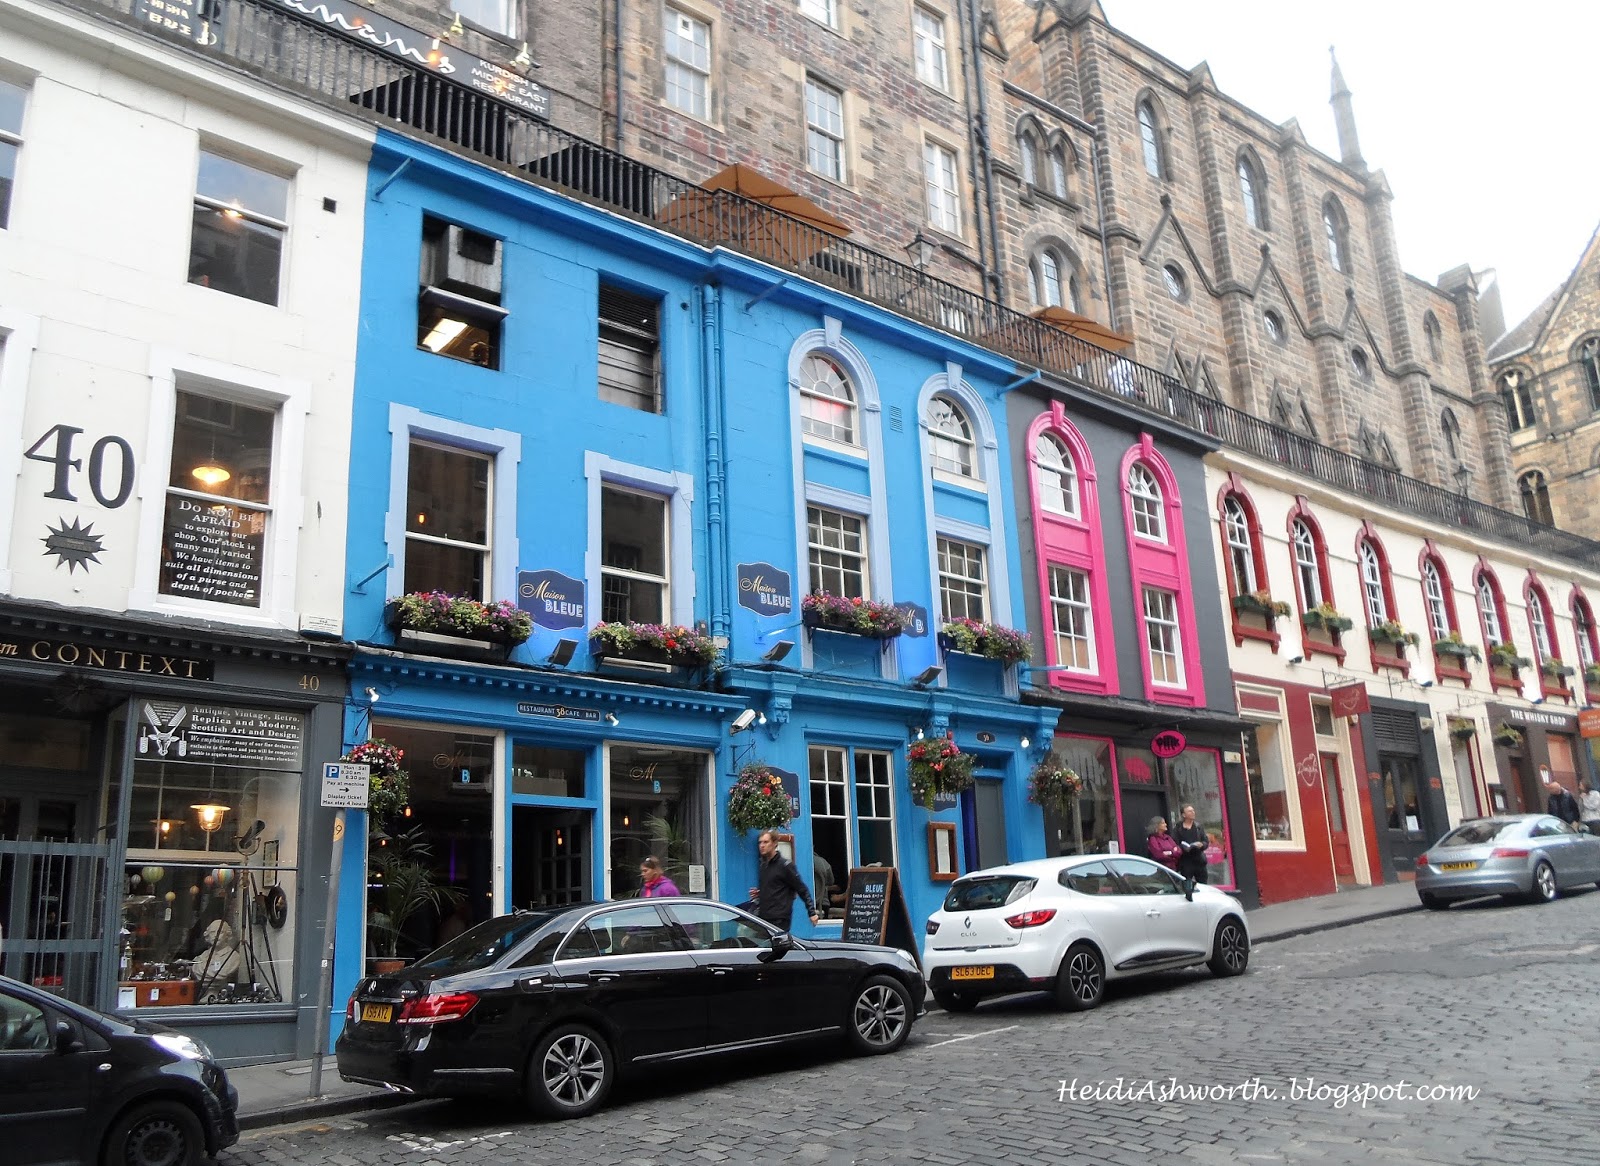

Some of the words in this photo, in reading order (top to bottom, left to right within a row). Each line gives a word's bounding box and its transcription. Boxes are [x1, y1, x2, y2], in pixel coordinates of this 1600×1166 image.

[480, 60, 529, 86] KURDISH
[531, 83, 540, 91] &
[471, 68, 516, 92] MIDDLE
[519, 87, 548, 104] EAST
[472, 79, 545, 113] RESTAURANT
[24, 424, 135, 509] 40
[207, 506, 234, 518] NOT
[192, 514, 241, 528] AFRAID
[196, 526, 229, 537] explore
[232, 531, 248, 539] our
[174, 532, 198, 542] shop.
[201, 535, 220, 545] Our
[221, 539, 245, 549] stock
[247, 543, 256, 551] is
[175, 541, 200, 551] many
[202, 546, 220, 554] and
[222, 550, 253, 560] varied.
[176, 551, 189, 560] We
[191, 554, 213, 564] have
[215, 558, 239, 568] items
[241, 562, 251, 570] to
[165, 561, 184, 569] suit
[186, 564, 201, 572] all
[203, 566, 259, 581] dimensions
[171, 581, 200, 592] depth
[203, 586, 214, 595] of
[176, 573, 188, 581] of
[198, 576, 227, 586] purse
[229, 580, 247, 589] and
[740, 575, 776, 595] Maison
[519, 580, 566, 603] Maison
[760, 592, 791, 608] BLEUE
[545, 600, 583, 617] BLEUE
[916, 618, 924, 633] B
[0, 643, 18, 656] m
[31, 641, 199, 678] CONTEXT
[299, 675, 320, 691] 40
[192, 706, 230, 716] Antique,
[235, 710, 271, 721] Vintage,
[519, 705, 555, 715] RESTAURANT
[556, 707, 565, 717] 38
[1510, 709, 1524, 720] THE
[1524, 711, 1549, 724] WHISKY
[1550, 715, 1566, 726] SHOP
[192, 714, 231, 724] Replica
[259, 721, 300, 730] Modern.
[191, 723, 228, 733] Scottish
[268, 730, 300, 739] Design.
[329, 767, 338, 777] P
[462, 769, 470, 783] B
[653, 781, 661, 794] B
[865, 884, 884, 893] BLEUE
[955, 967, 974, 977] SL63
